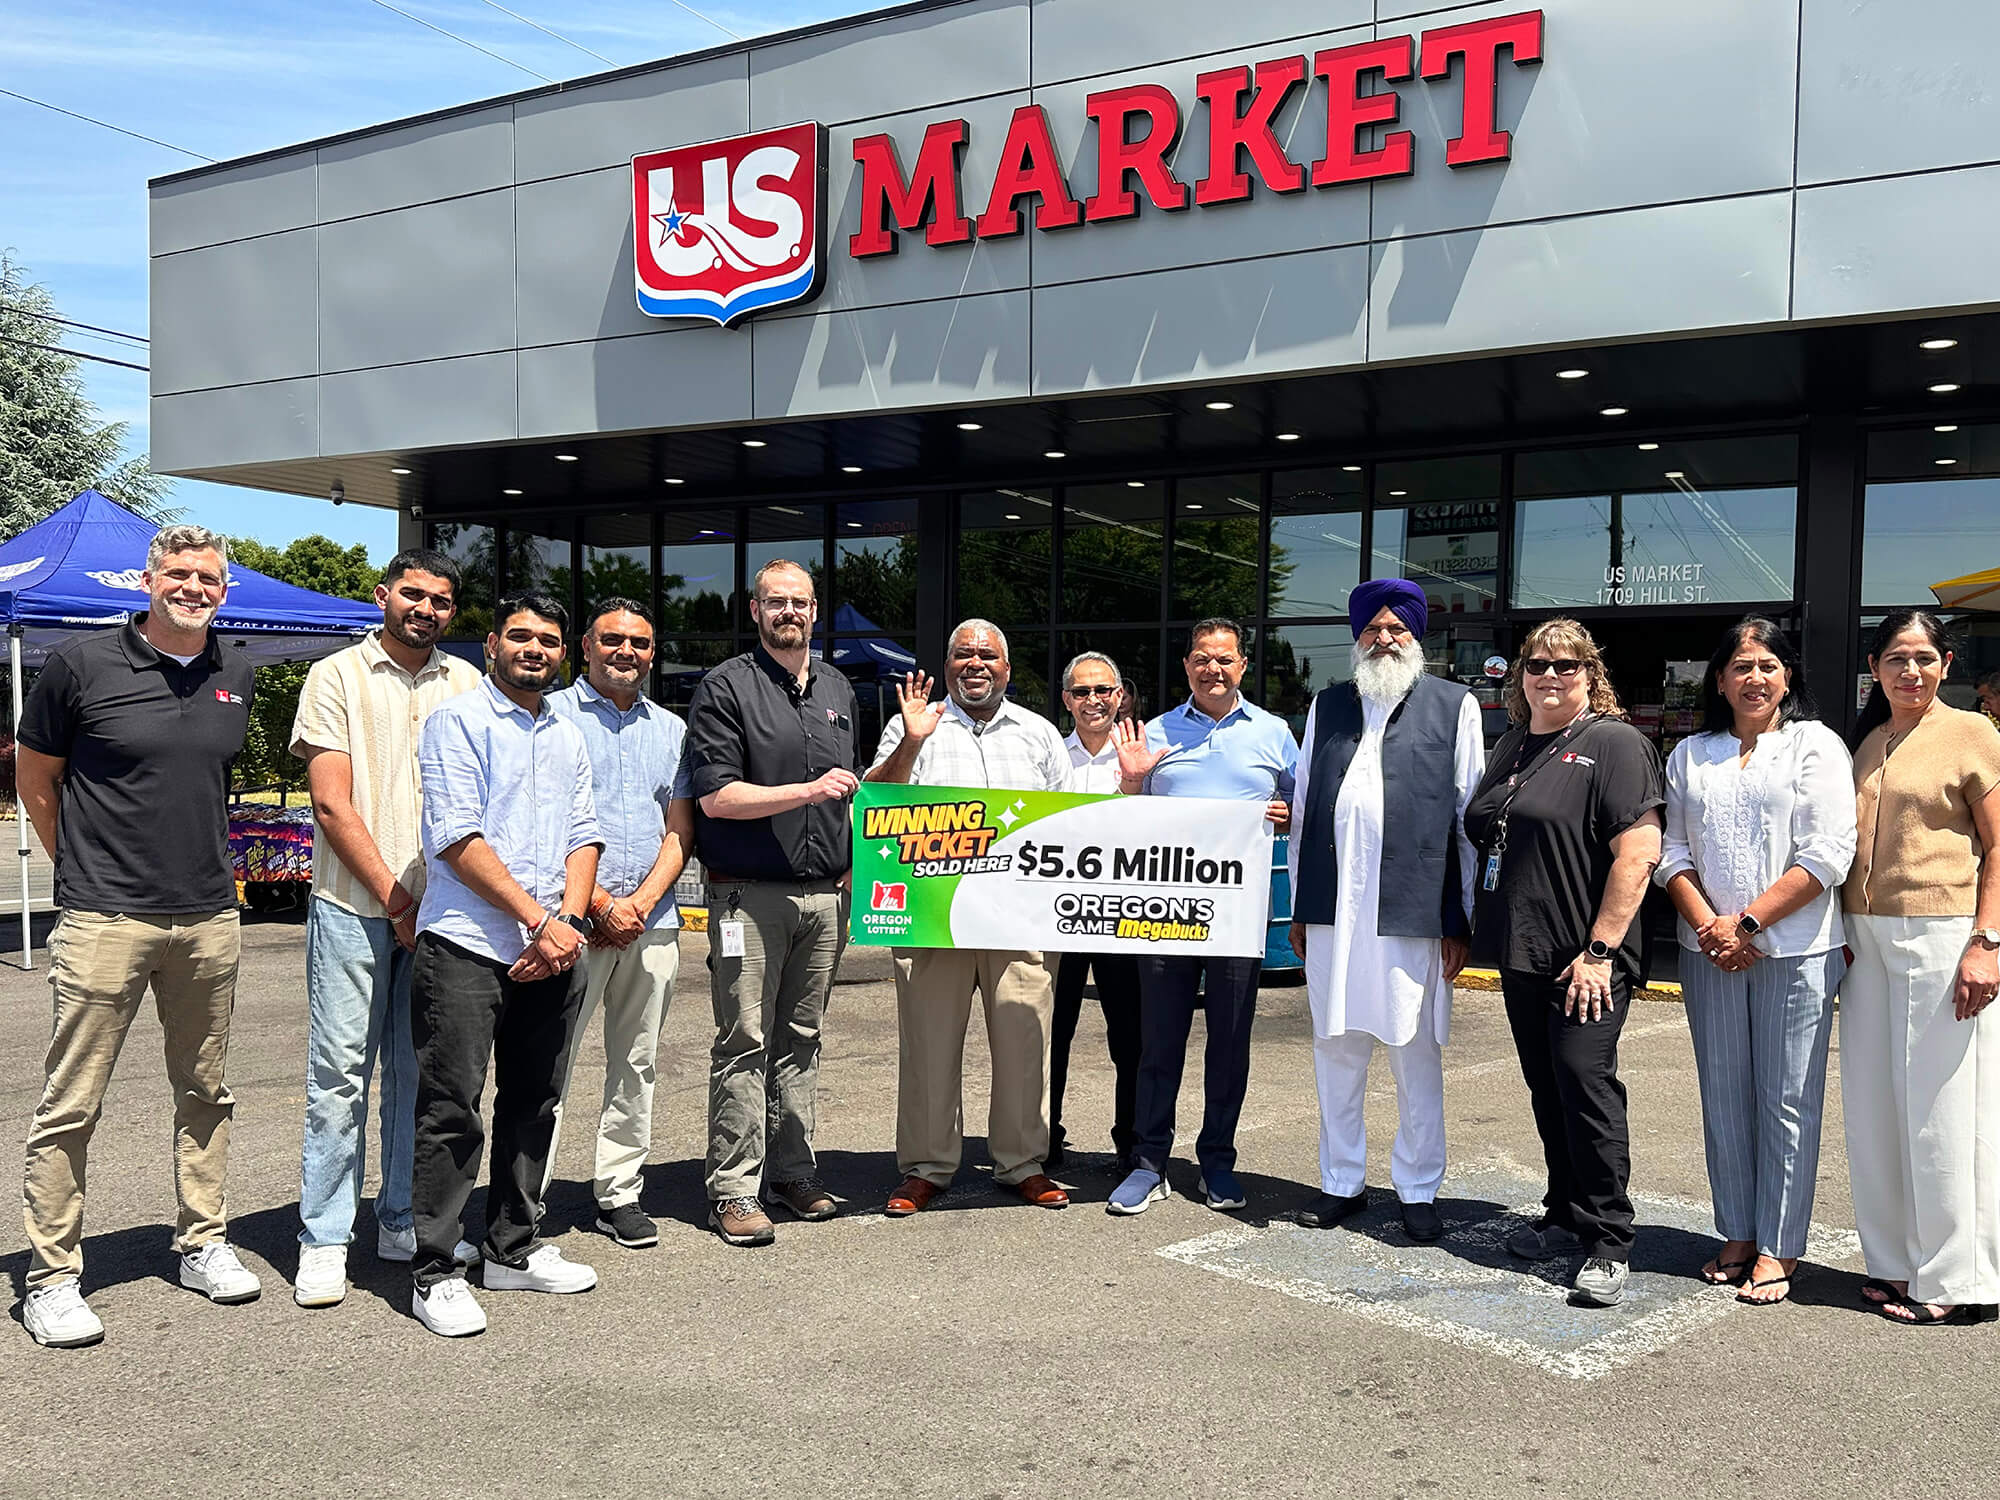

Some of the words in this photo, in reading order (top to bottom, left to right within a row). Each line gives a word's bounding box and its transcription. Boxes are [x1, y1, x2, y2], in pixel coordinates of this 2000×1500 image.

[850, 9, 1544, 259] MARKET
[1603, 566, 1626, 584] US
[1632, 564, 1704, 583] MARKET
[1596, 587, 1634, 605] 1709
[1640, 586, 1679, 604] HILL
[1683, 585, 1711, 602] ST.
[865, 801, 985, 837] WINNING
[899, 828, 996, 863] TICKET
[913, 860, 962, 877] SOLD
[962, 856, 1011, 874] HERE
[1017, 840, 1103, 880] $5.6
[1113, 845, 1243, 885] Million
[862, 914, 912, 925] OREGON
[1055, 893, 1214, 922] OREGON'S
[1057, 918, 1116, 935] GAME
[1116, 918, 1210, 942] megabucks
